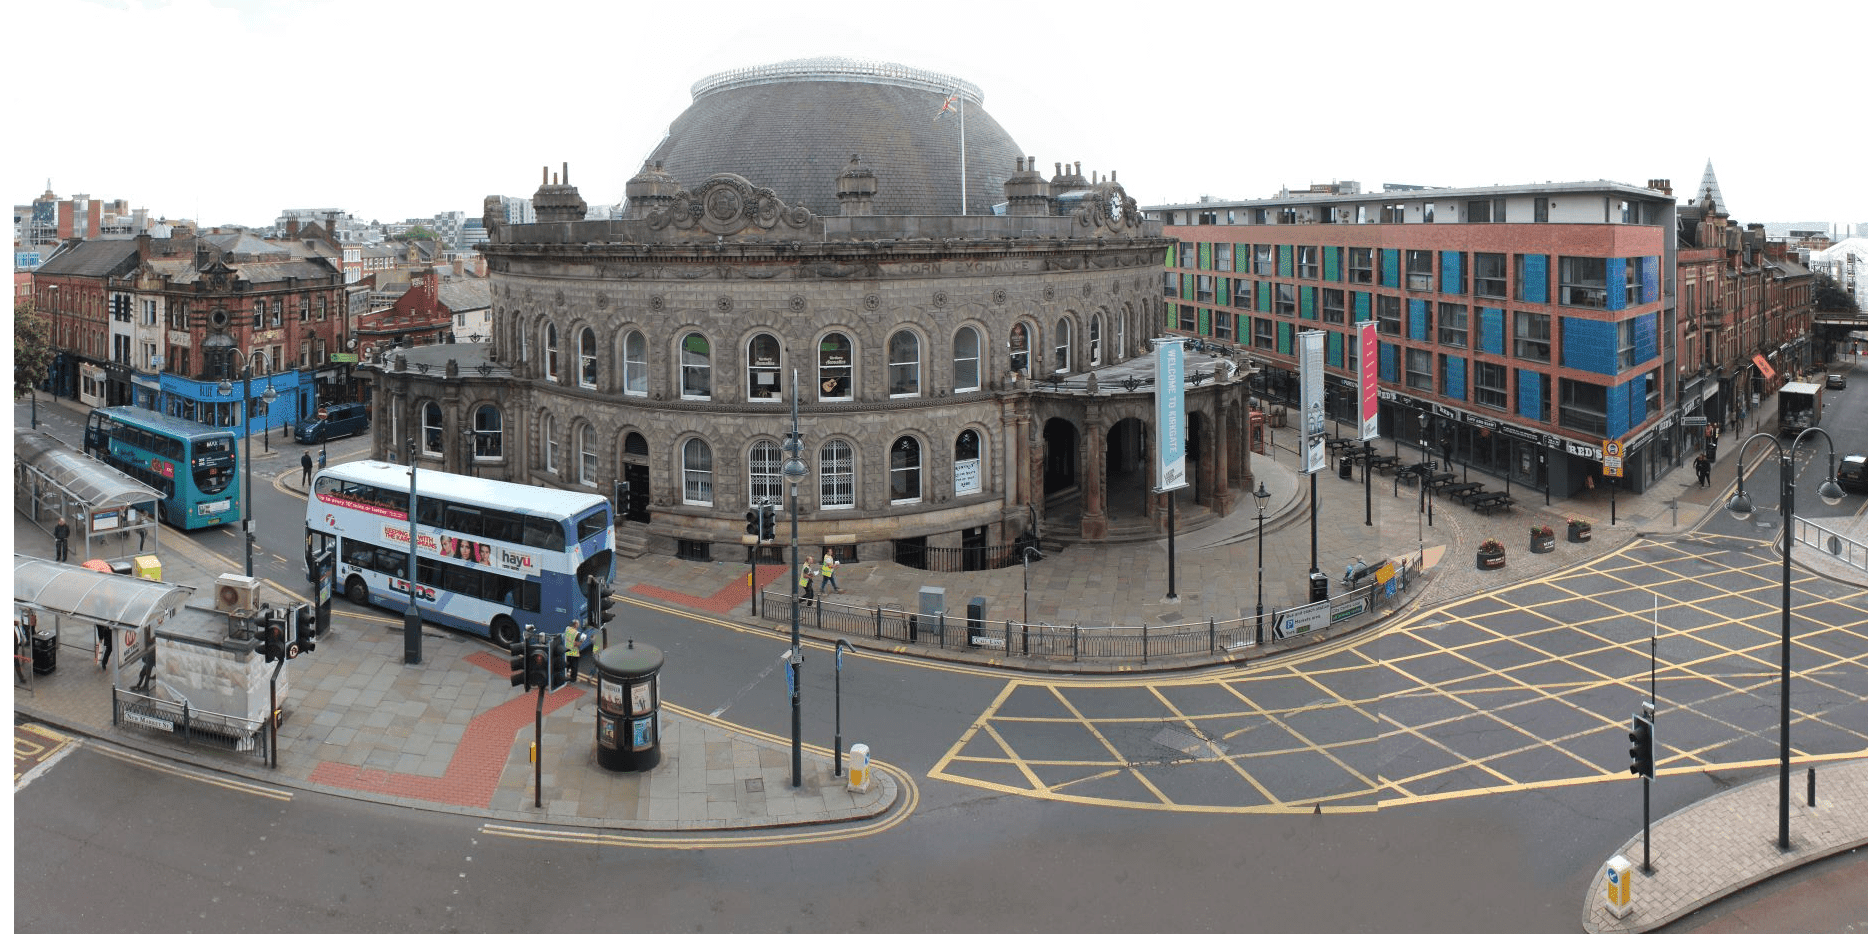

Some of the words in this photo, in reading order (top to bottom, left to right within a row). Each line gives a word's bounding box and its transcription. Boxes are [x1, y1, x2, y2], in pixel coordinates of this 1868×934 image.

[900, 262, 941, 275] CORN
[955, 260, 1030, 274] EXCHANGE
[1167, 348, 1177, 394] WELCOME
[200, 384, 214, 398] BLUE
[1168, 396, 1177, 408] TO
[1168, 410, 1178, 454] KIRKGATE
[1568, 444, 1603, 460] RED'S
[123, 642, 140, 656] METRO
